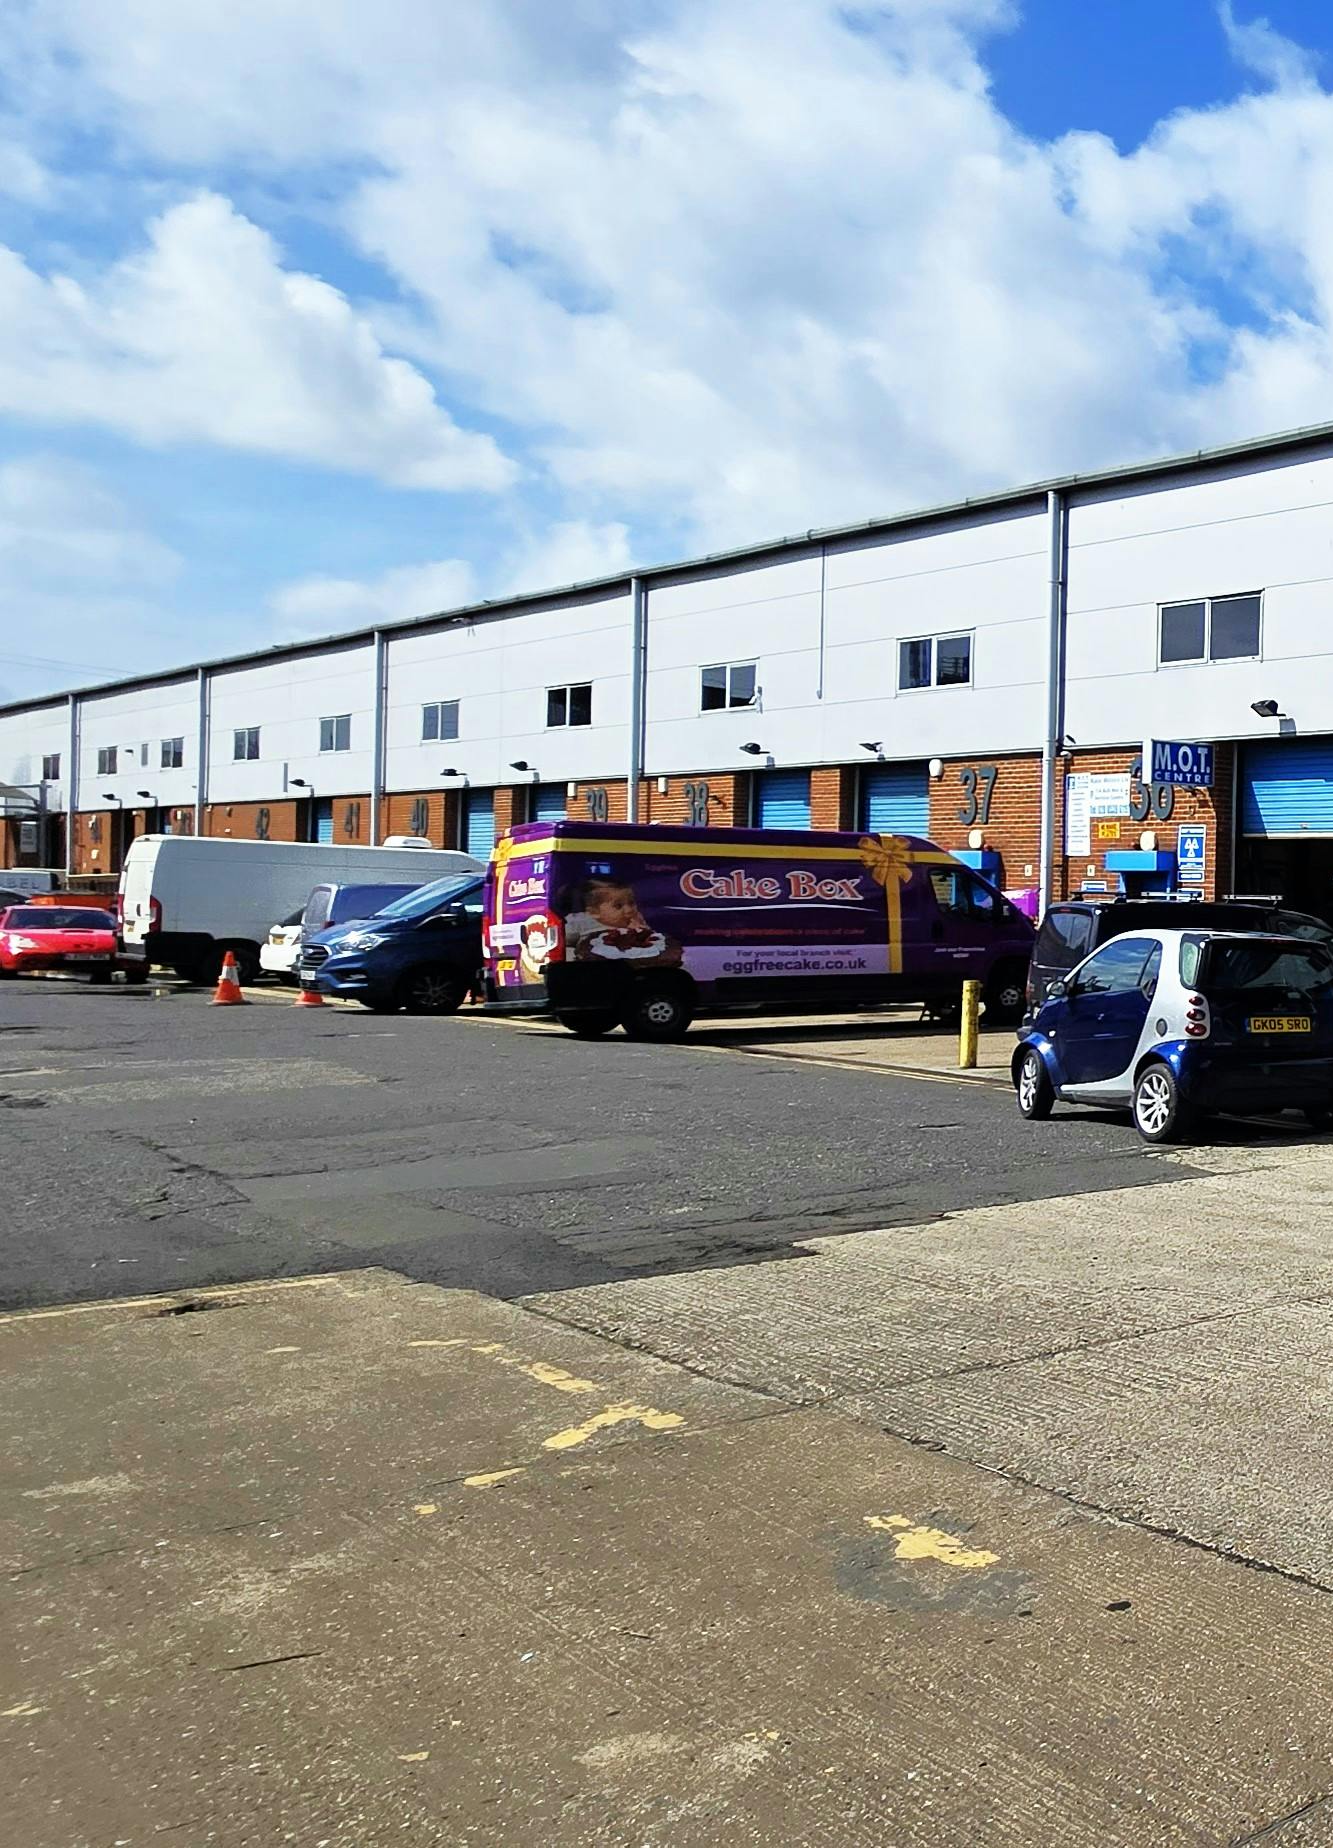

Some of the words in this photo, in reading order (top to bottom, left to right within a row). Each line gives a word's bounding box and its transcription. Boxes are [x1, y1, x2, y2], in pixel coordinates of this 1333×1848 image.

[1155, 743, 1211, 772] M.O.T.
[1154, 770, 1211, 784] CENTRE
[684, 781, 709, 827] 38
[958, 766, 997, 825] 37
[680, 868, 782, 900] Cake
[785, 871, 864, 900] Box
[722, 958, 867, 974] eggfreecake.co.uk
[1253, 1018, 1284, 1030] GK05
